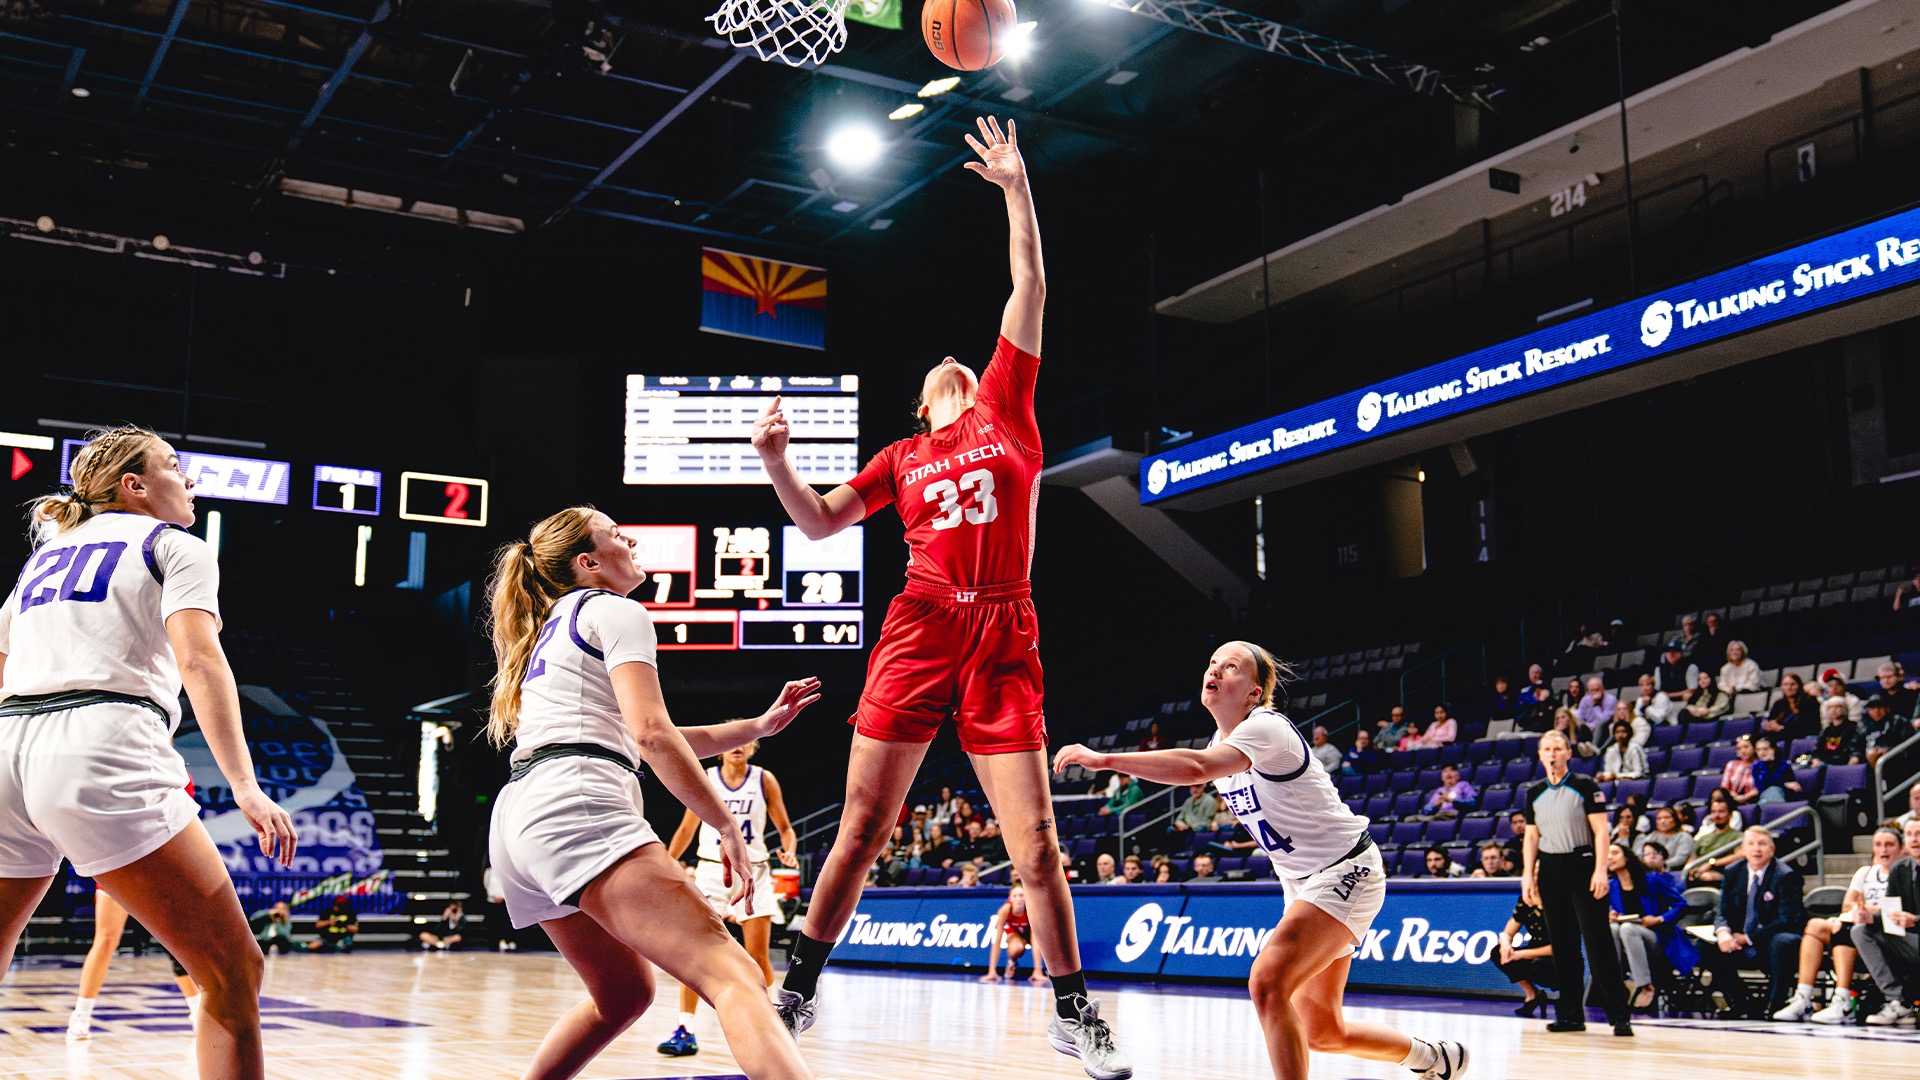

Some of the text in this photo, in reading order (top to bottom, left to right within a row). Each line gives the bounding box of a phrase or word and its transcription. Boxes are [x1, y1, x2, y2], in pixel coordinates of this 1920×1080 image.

[932, 20, 944, 51] GCU
[1550, 181, 1587, 218] 214
[185, 456, 286, 501] GCU
[905, 442, 1006, 486] UTAH TECH
[339, 482, 355, 511] 1
[443, 481, 469, 519] 2
[923, 468, 998, 531] 33
[19, 541, 128, 615] 20
[740, 557, 756, 576] 2
[653, 573, 672, 603] 7
[674, 623, 687, 643] 1
[792, 623, 805, 643] 1
[1243, 818, 1296, 854] 4
[1392, 917, 1533, 965] RESO
